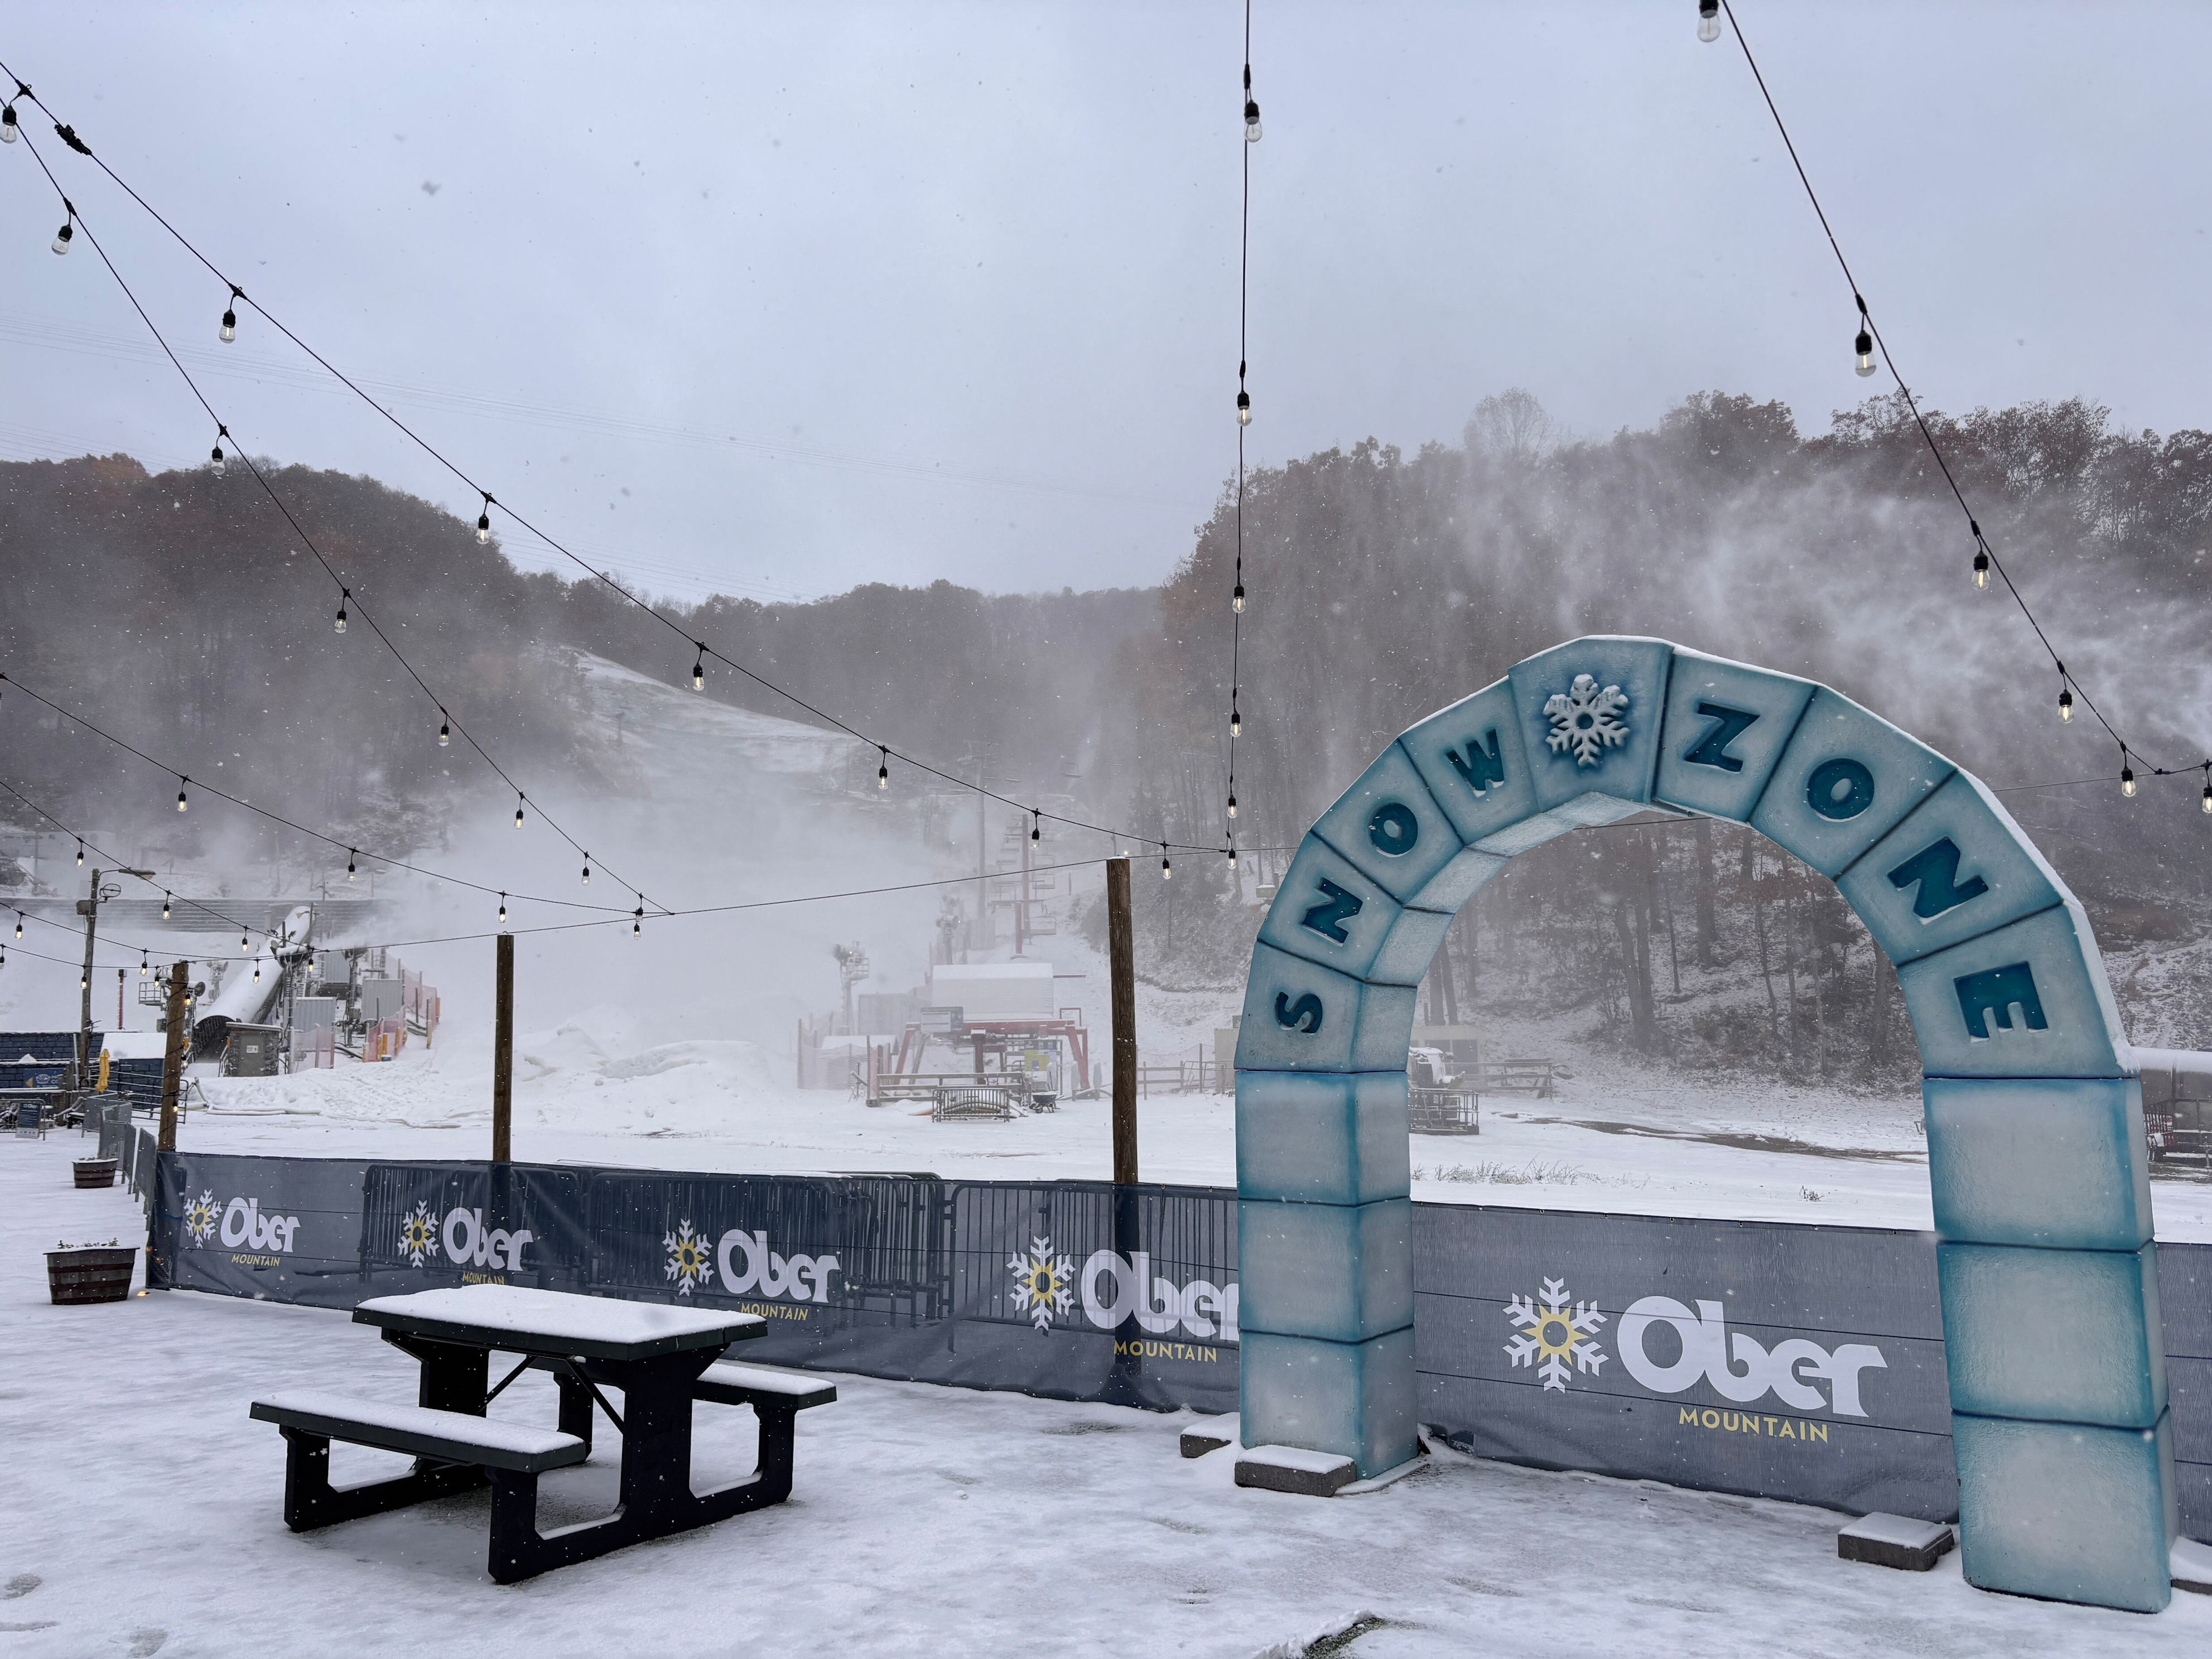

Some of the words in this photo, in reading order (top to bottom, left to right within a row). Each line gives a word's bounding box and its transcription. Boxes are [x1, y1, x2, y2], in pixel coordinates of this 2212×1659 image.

[1275, 729, 1505, 1035] SNOW
[1685, 702, 2049, 1042] ZONE
[220, 1197, 301, 1252] Ober
[443, 1207, 534, 1271] Ober
[232, 1255, 280, 1267] MOUNTAIN
[462, 1271, 505, 1285] MOUNTAIN
[717, 1228, 841, 1304] Ober
[741, 1302, 808, 1321] MOUNTAIN
[1114, 1340, 1217, 1363] MOUNTAIN
[1617, 1296, 1888, 1417] Ober
[1679, 1407, 1828, 1444] MOUNTAIN
